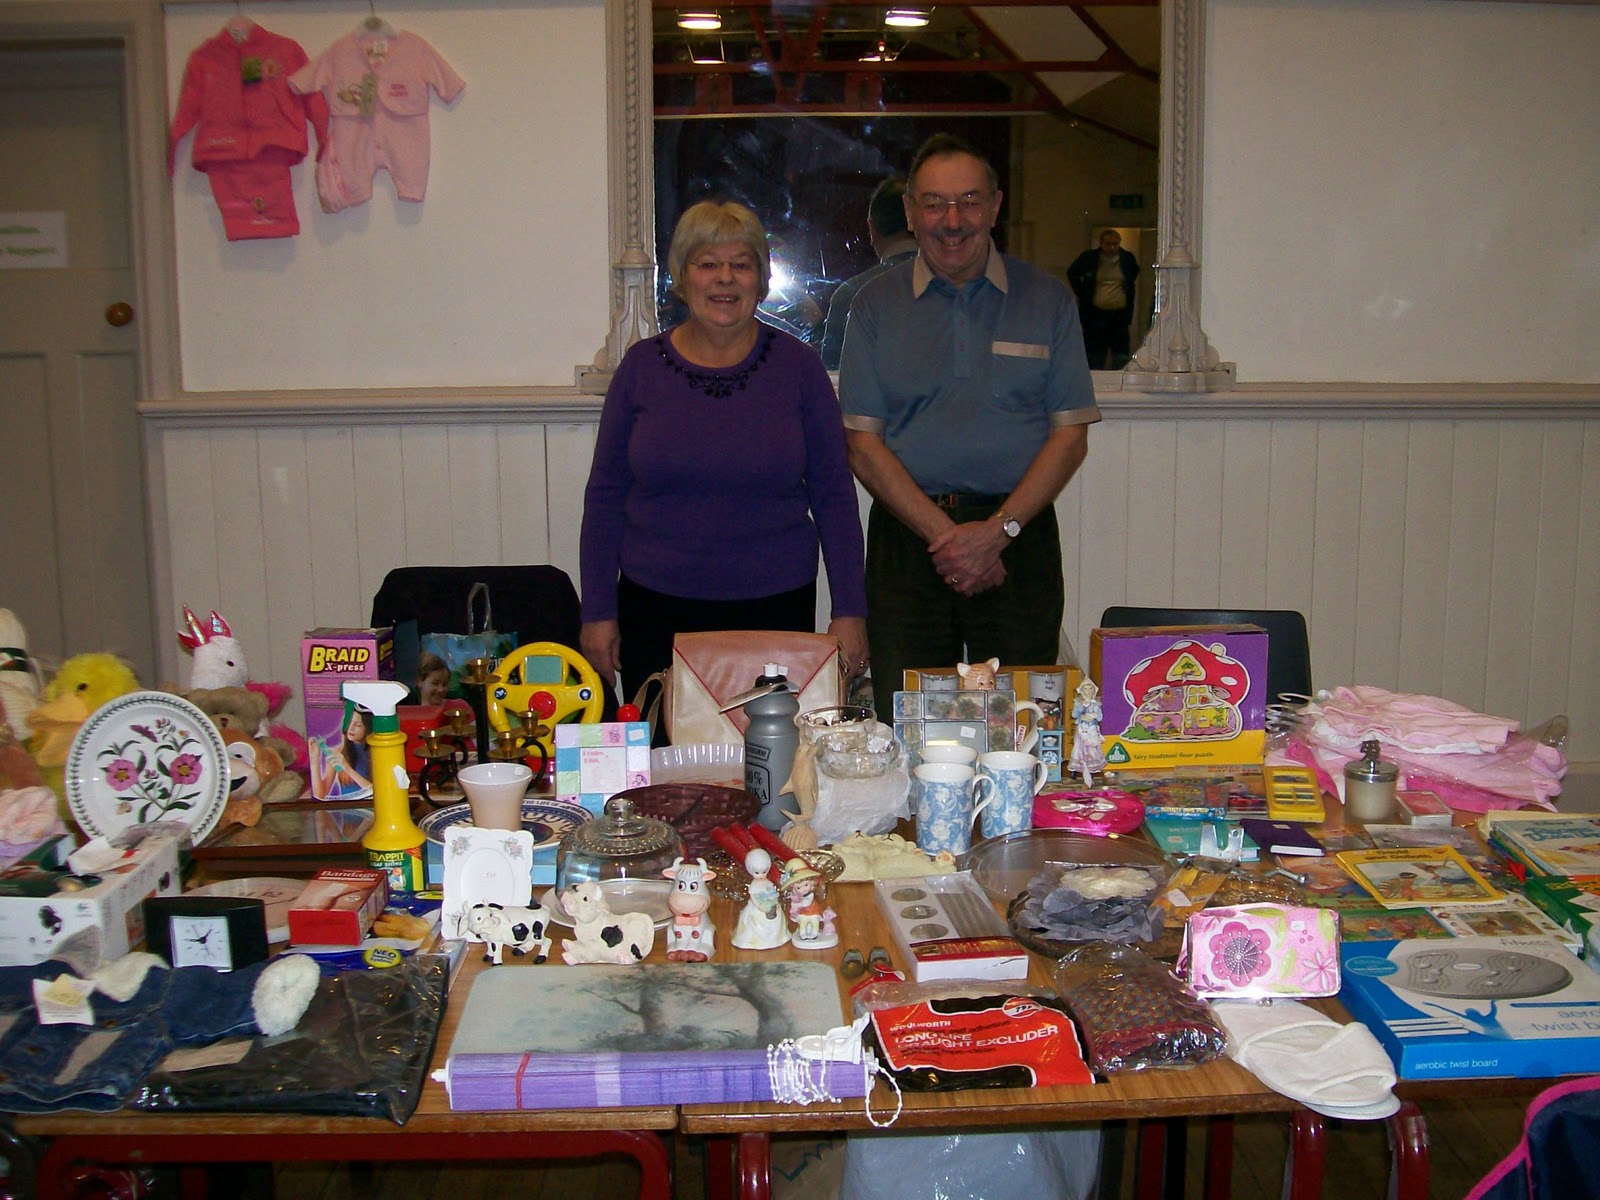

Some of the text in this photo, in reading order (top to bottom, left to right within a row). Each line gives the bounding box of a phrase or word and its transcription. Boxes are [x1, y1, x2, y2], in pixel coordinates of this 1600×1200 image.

[309, 646, 370, 672] BRAID
[325, 663, 365, 672] X-press
[369, 851, 405, 861] TRAPPIT
[320, 870, 379, 878] Bandage
[895, 1030, 938, 1044] LONG
[940, 1033, 973, 1041] LIFE
[975, 1025, 1060, 1047] EXCLUDER
[1414, 1059, 1499, 1071] aerobic twist board
